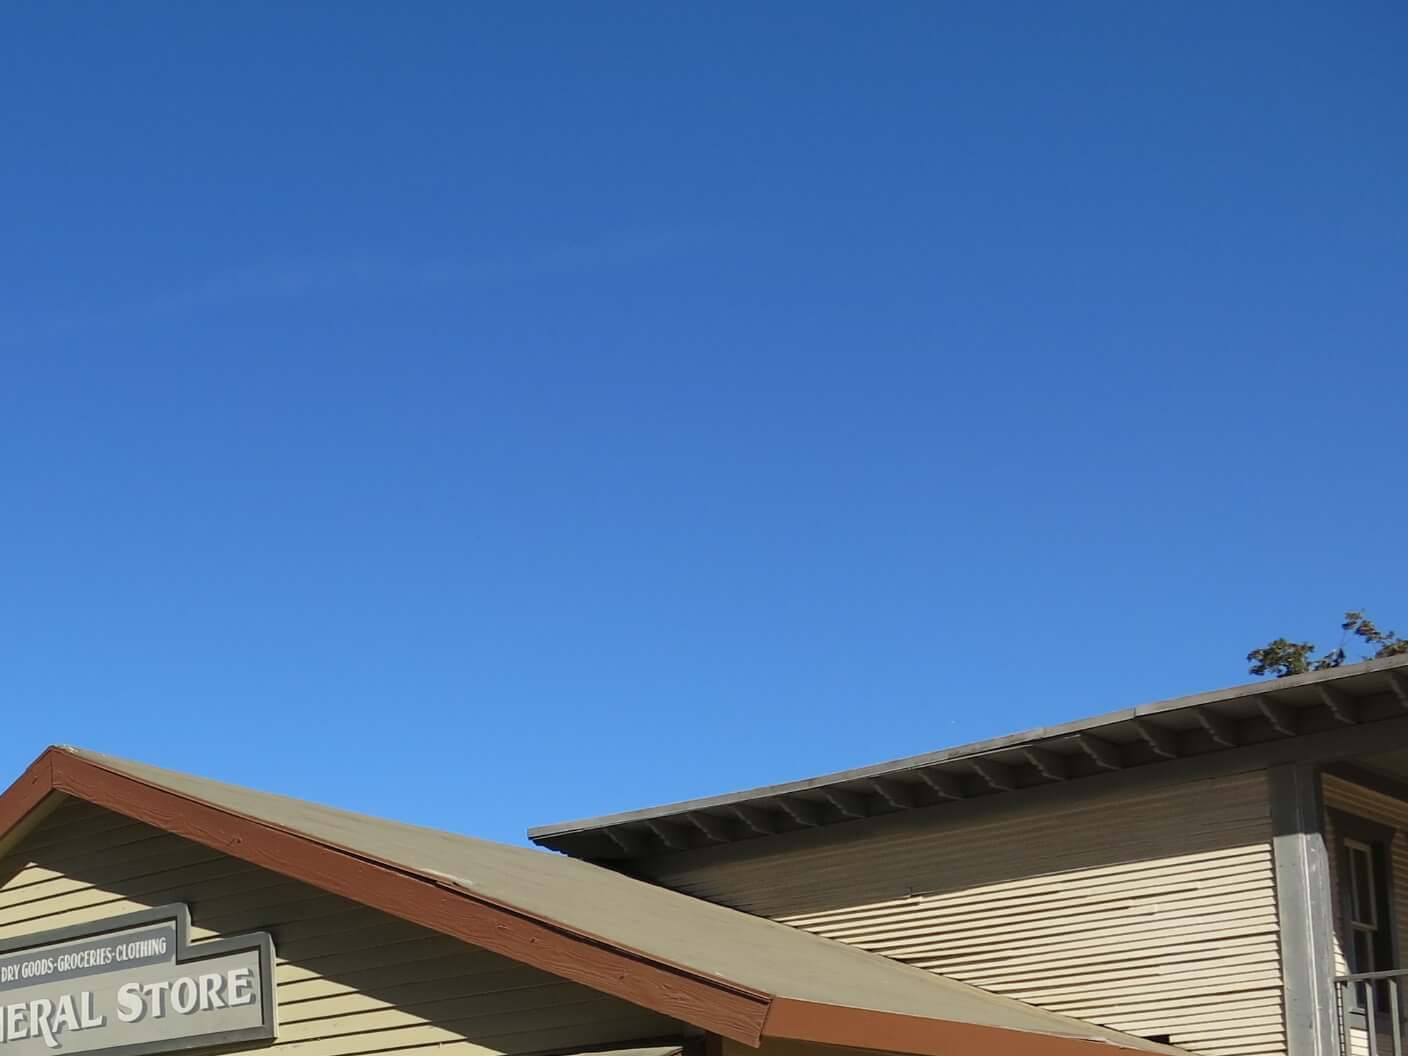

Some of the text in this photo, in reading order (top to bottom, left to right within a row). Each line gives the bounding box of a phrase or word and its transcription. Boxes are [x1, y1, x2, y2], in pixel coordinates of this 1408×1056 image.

[0, 964, 21, 983] DRY
[115, 936, 167, 962] CLOTHING
[116, 967, 255, 1023] STORE
